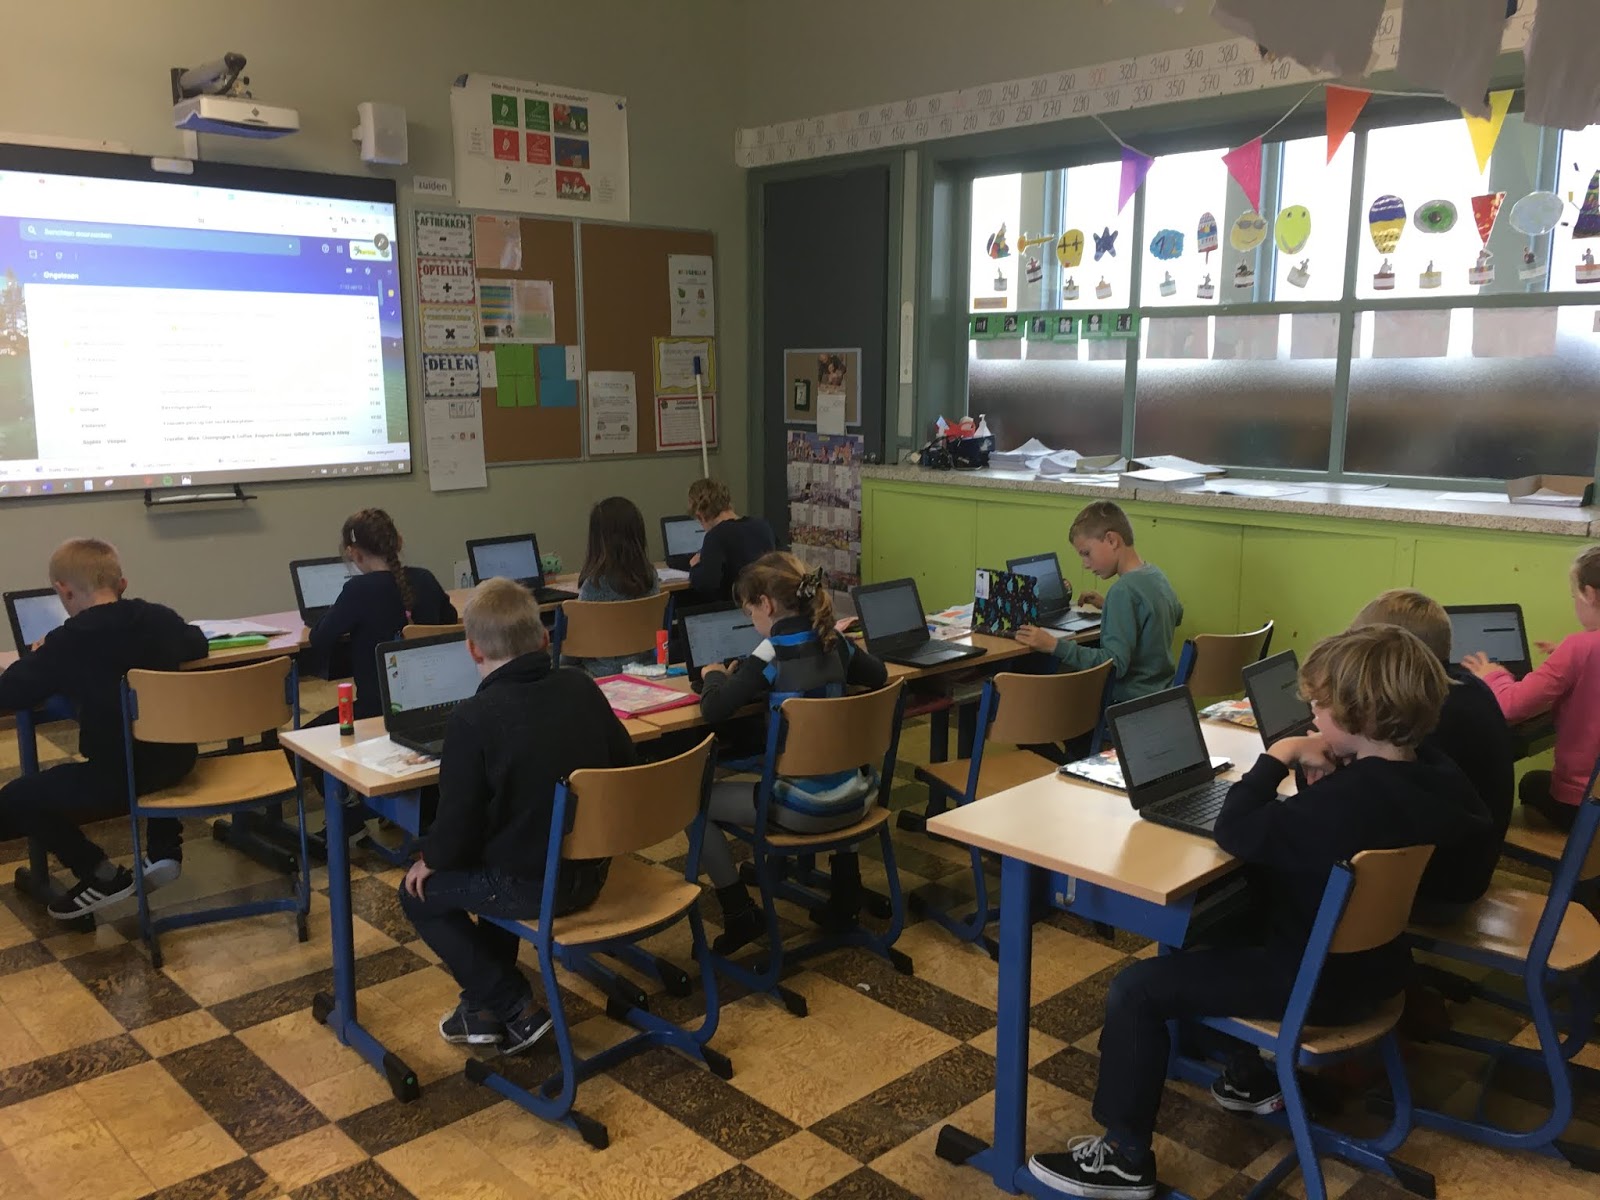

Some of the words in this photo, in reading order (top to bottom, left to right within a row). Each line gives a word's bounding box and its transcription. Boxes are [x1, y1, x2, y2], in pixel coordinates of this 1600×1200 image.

[977, 88, 992, 105] 220
[1002, 83, 1020, 101] 240
[1031, 79, 1048, 97] 260
[1057, 73, 1076, 92] 280
[1119, 62, 1137, 81] 320
[1150, 55, 1170, 75] 340
[1183, 49, 1204, 70] 360
[1217, 43, 1239, 64] 380
[891, 126, 905, 142] 150
[915, 121, 929, 137] 170
[963, 113, 979, 131] 210
[989, 109, 1006, 127] 230
[1015, 104, 1033, 122] 250
[1042, 99, 1062, 119] 270
[1072, 94, 1091, 113] 290
[1103, 89, 1121, 108] 310
[1133, 83, 1153, 102] 330
[1165, 79, 1185, 98] 350
[1198, 73, 1221, 93] 370
[1233, 67, 1255, 87] 390
[1270, 61, 1292, 80] 410
[419, 216, 466, 229] AFTREKKEN
[422, 263, 469, 277] OPTELLEN
[428, 357, 475, 371] DELEN
